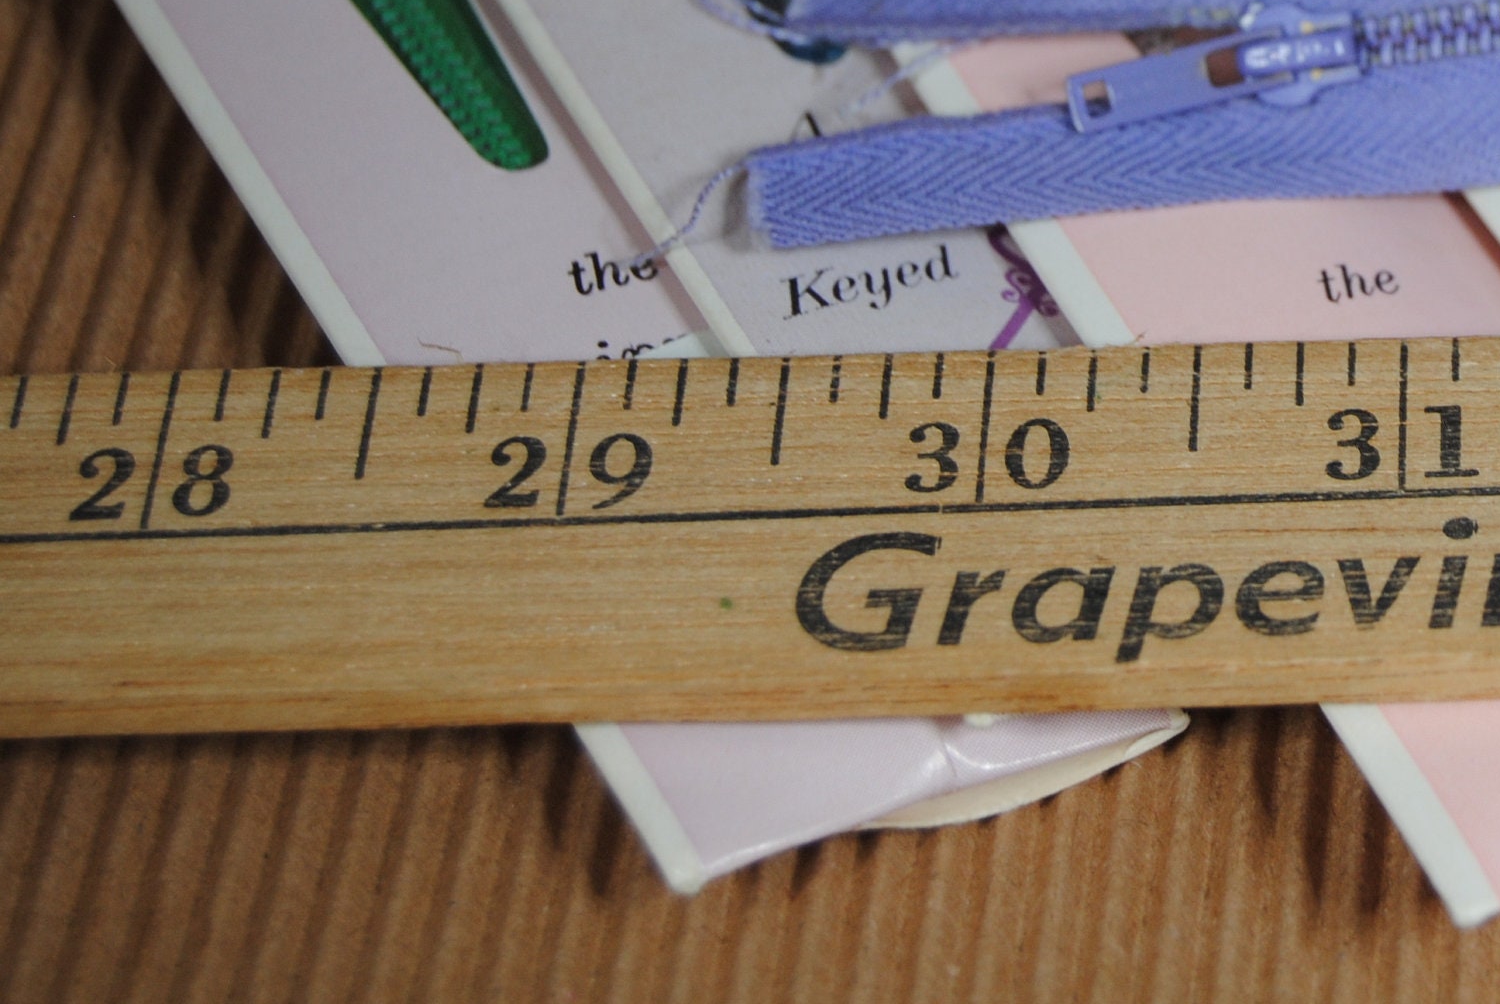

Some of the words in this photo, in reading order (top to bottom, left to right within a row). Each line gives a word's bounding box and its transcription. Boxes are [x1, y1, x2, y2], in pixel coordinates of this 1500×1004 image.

[568, 252, 659, 296] the
[780, 244, 958, 321] Keyed
[1316, 263, 1402, 305] the
